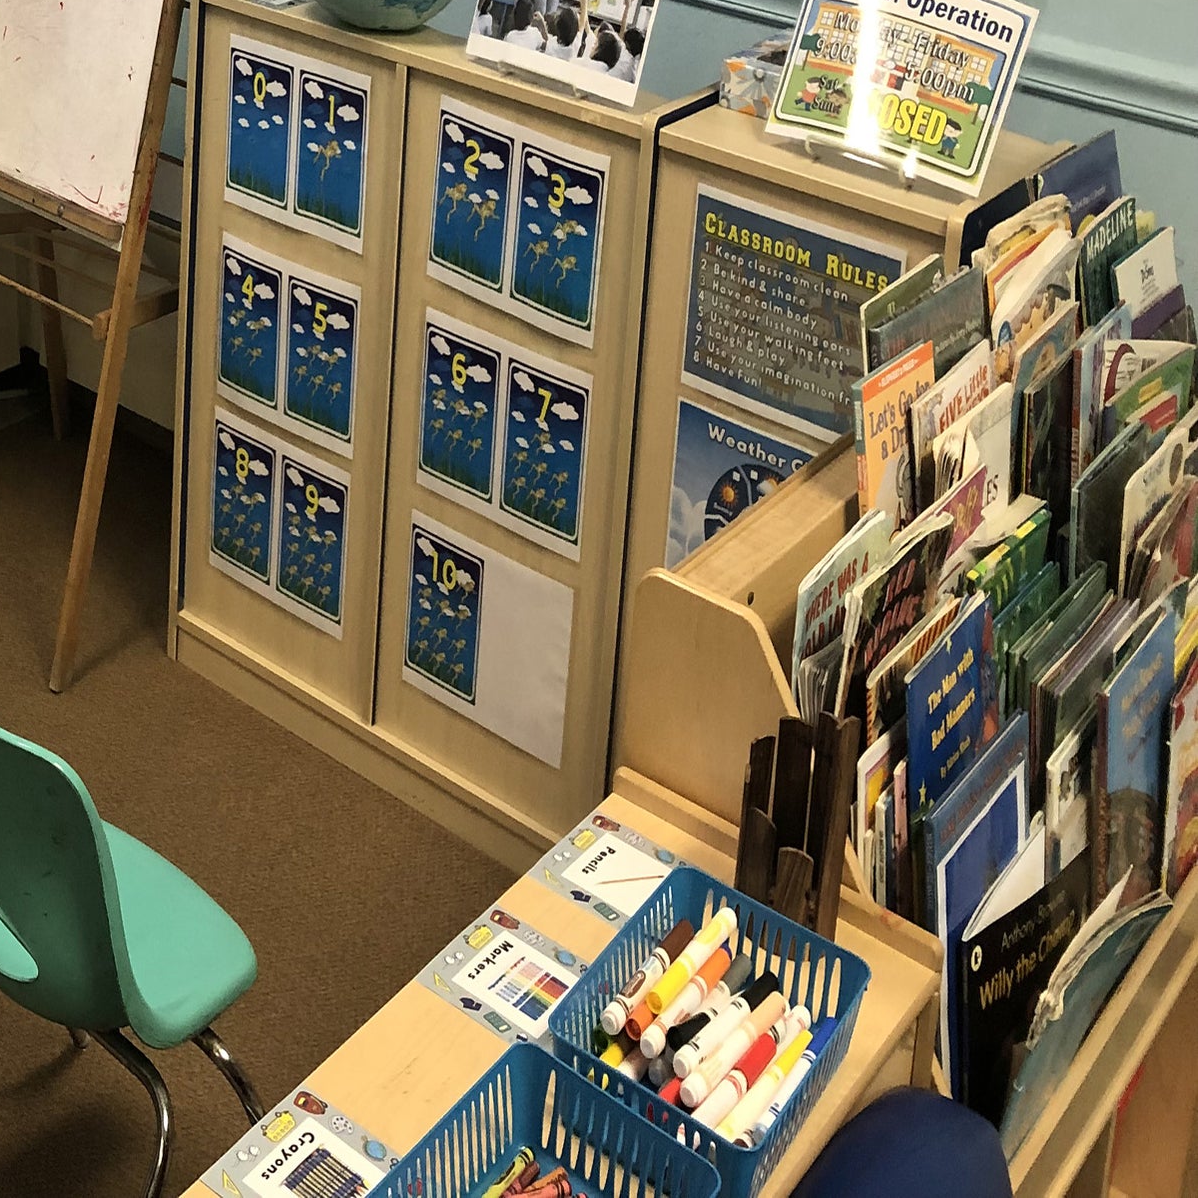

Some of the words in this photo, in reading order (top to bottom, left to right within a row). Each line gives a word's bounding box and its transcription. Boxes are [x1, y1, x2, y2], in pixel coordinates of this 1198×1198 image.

[914, 32, 970, 70] Friday
[254, 72, 266, 102] 0
[904, 62, 974, 103] 5:00pm
[329, 95, 335, 126] 1
[878, 93, 948, 146] OSED
[464, 140, 480, 175] 2
[548, 174, 565, 208] 3
[705, 212, 811, 268] CLASSROOM
[826, 254, 889, 292] RULES
[1086, 201, 1134, 264] MADELINE
[242, 274, 254, 304] 4
[714, 264, 727, 278] Be
[730, 269, 756, 288] kind
[759, 280, 767, 293] &
[772, 287, 806, 306] share
[716, 245, 744, 266] Keep
[748, 258, 810, 289] classroom
[814, 282, 849, 302] clean
[312, 302, 327, 333] 5
[712, 280, 741, 299] Have
[744, 294, 751, 303] a
[755, 296, 783, 315] calm
[787, 307, 817, 330] body
[709, 326, 742, 348] Laugh
[746, 340, 753, 351] &
[758, 346, 785, 366] play
[710, 311, 730, 327] Use
[734, 323, 760, 339] your
[764, 335, 813, 362] walking
[818, 351, 844, 370] feet
[711, 296, 731, 311] Use
[734, 307, 761, 322] your
[765, 317, 819, 347] listening
[822, 339, 851, 356] ears
[451, 353, 467, 385] 6
[706, 356, 734, 377] Have
[707, 341, 727, 357] Use
[731, 353, 757, 370] your
[761, 366, 835, 400] imagination
[537, 388, 552, 421] 7
[869, 400, 895, 438] Let's
[898, 390, 913, 417] Go
[236, 448, 249, 477] 8
[707, 422, 786, 471] Weather
[306, 484, 319, 514] 9
[430, 551, 457, 590] 10
[837, 558, 857, 599] WAS
[862, 551, 868, 576] A
[928, 689, 942, 715] The
[942, 672, 957, 698] Man
[957, 647, 974, 676] with
[931, 719, 946, 751] Bad
[946, 688, 976, 733] Manners
[582, 846, 617, 875] Pencils
[467, 940, 514, 980] Markers
[980, 967, 1013, 1010] Willy
[1016, 952, 1037, 982] the
[261, 1131, 316, 1181] Crayons
